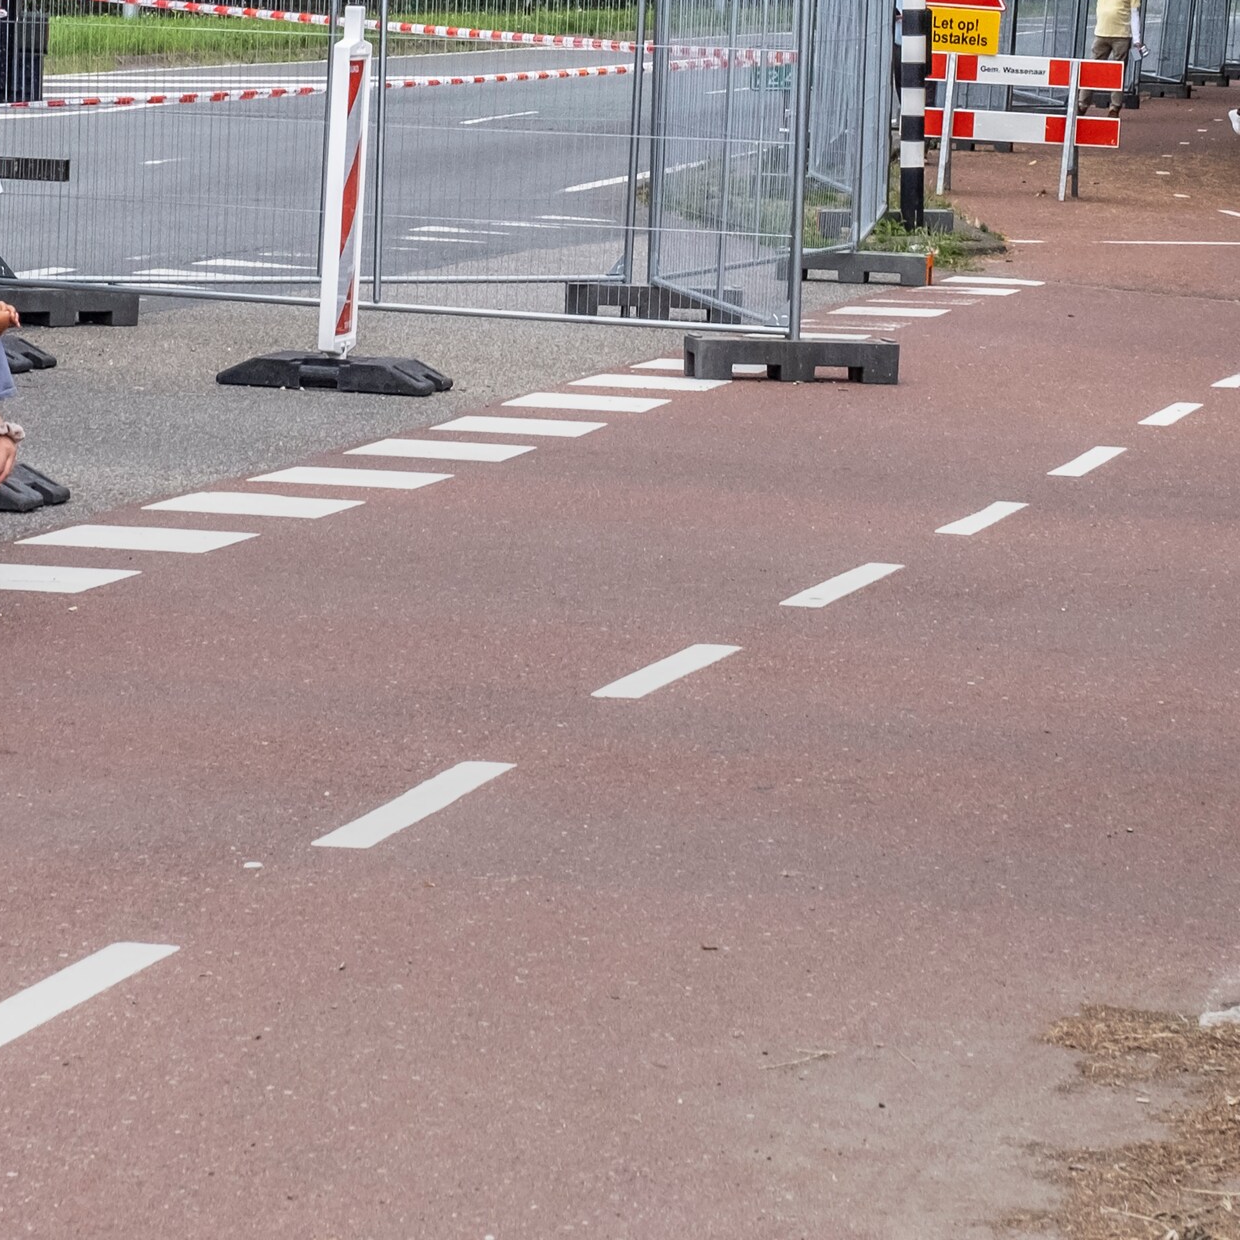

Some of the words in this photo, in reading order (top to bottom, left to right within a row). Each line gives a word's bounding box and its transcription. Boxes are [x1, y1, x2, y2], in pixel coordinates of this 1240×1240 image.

[932, 15, 954, 30] Let
[959, 19, 979, 34] op!
[932, 31, 988, 47] bstakels
[980, 64, 1001, 74] Gem.
[1002, 65, 1047, 76] Wassenaar
